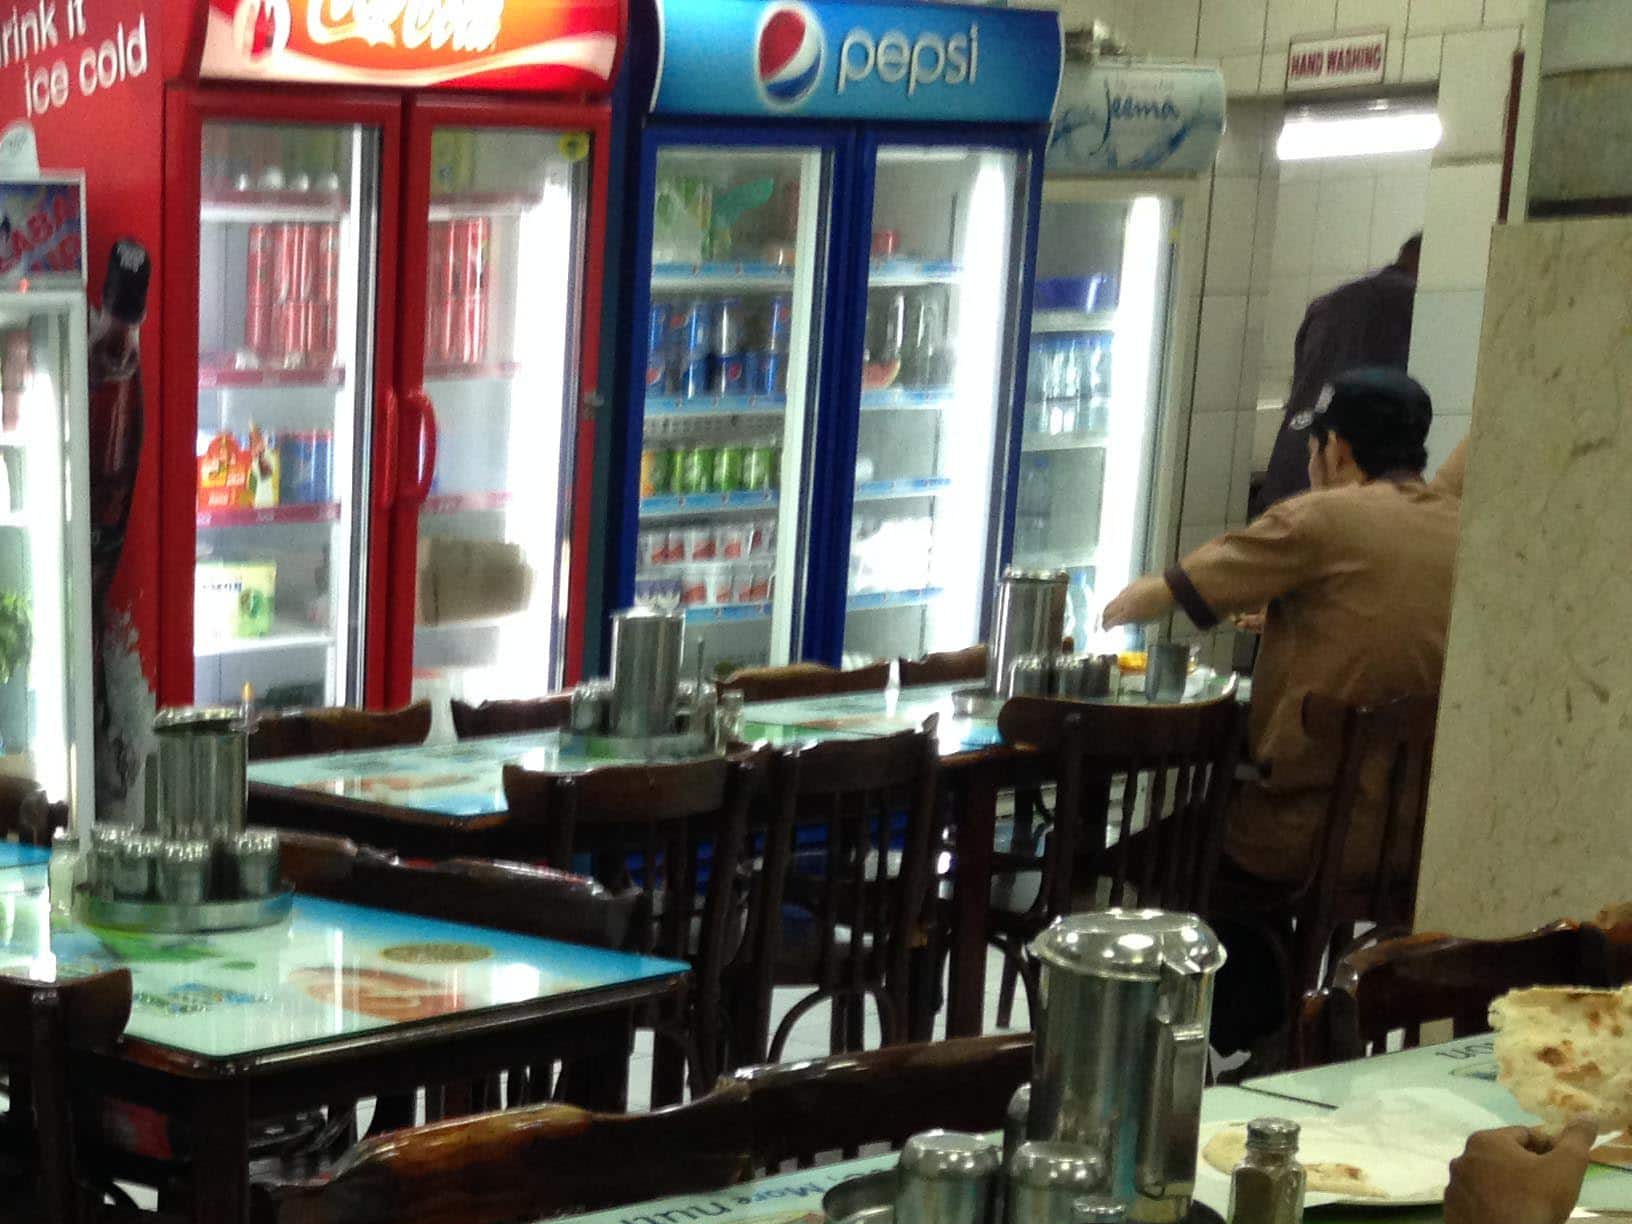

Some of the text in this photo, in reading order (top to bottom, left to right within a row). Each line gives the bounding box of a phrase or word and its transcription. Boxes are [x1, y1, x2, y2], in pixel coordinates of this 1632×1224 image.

[68, 0, 86, 40] it
[23, 12, 148, 118] ice cold
[837, 22, 979, 97] pepsi
[1290, 43, 1382, 77] HAND WASHING
